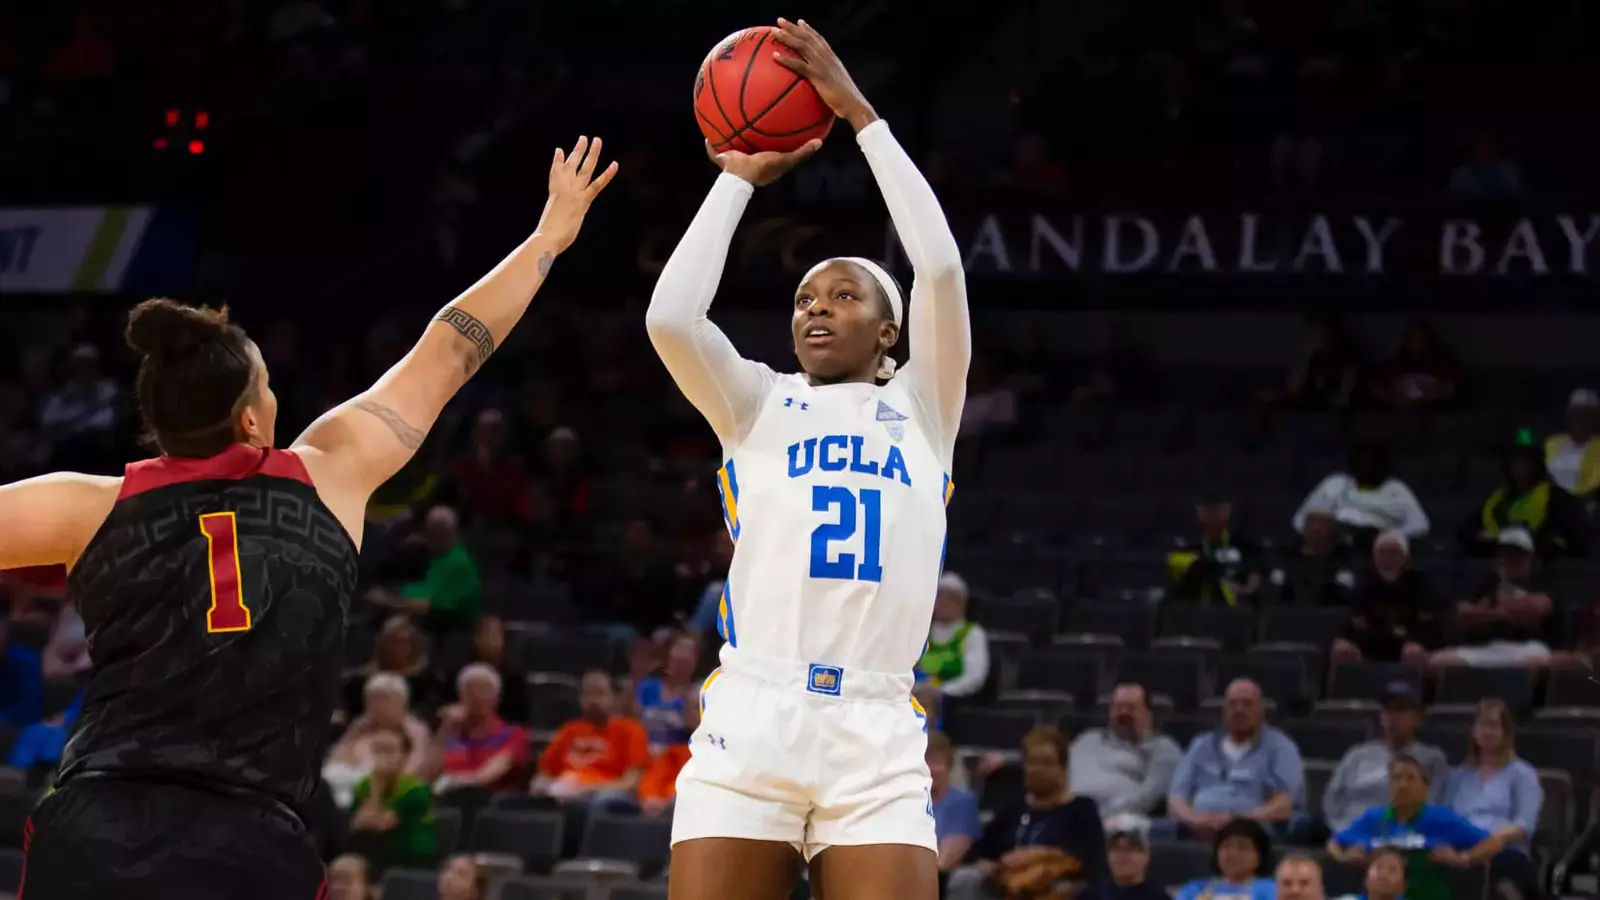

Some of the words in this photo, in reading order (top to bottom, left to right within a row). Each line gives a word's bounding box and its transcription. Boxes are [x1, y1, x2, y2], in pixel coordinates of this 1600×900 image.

[1438, 213, 1600, 276] BAY
[787, 434, 912, 487] UCLA
[199, 511, 252, 633] 1
[809, 485, 882, 582] 21
